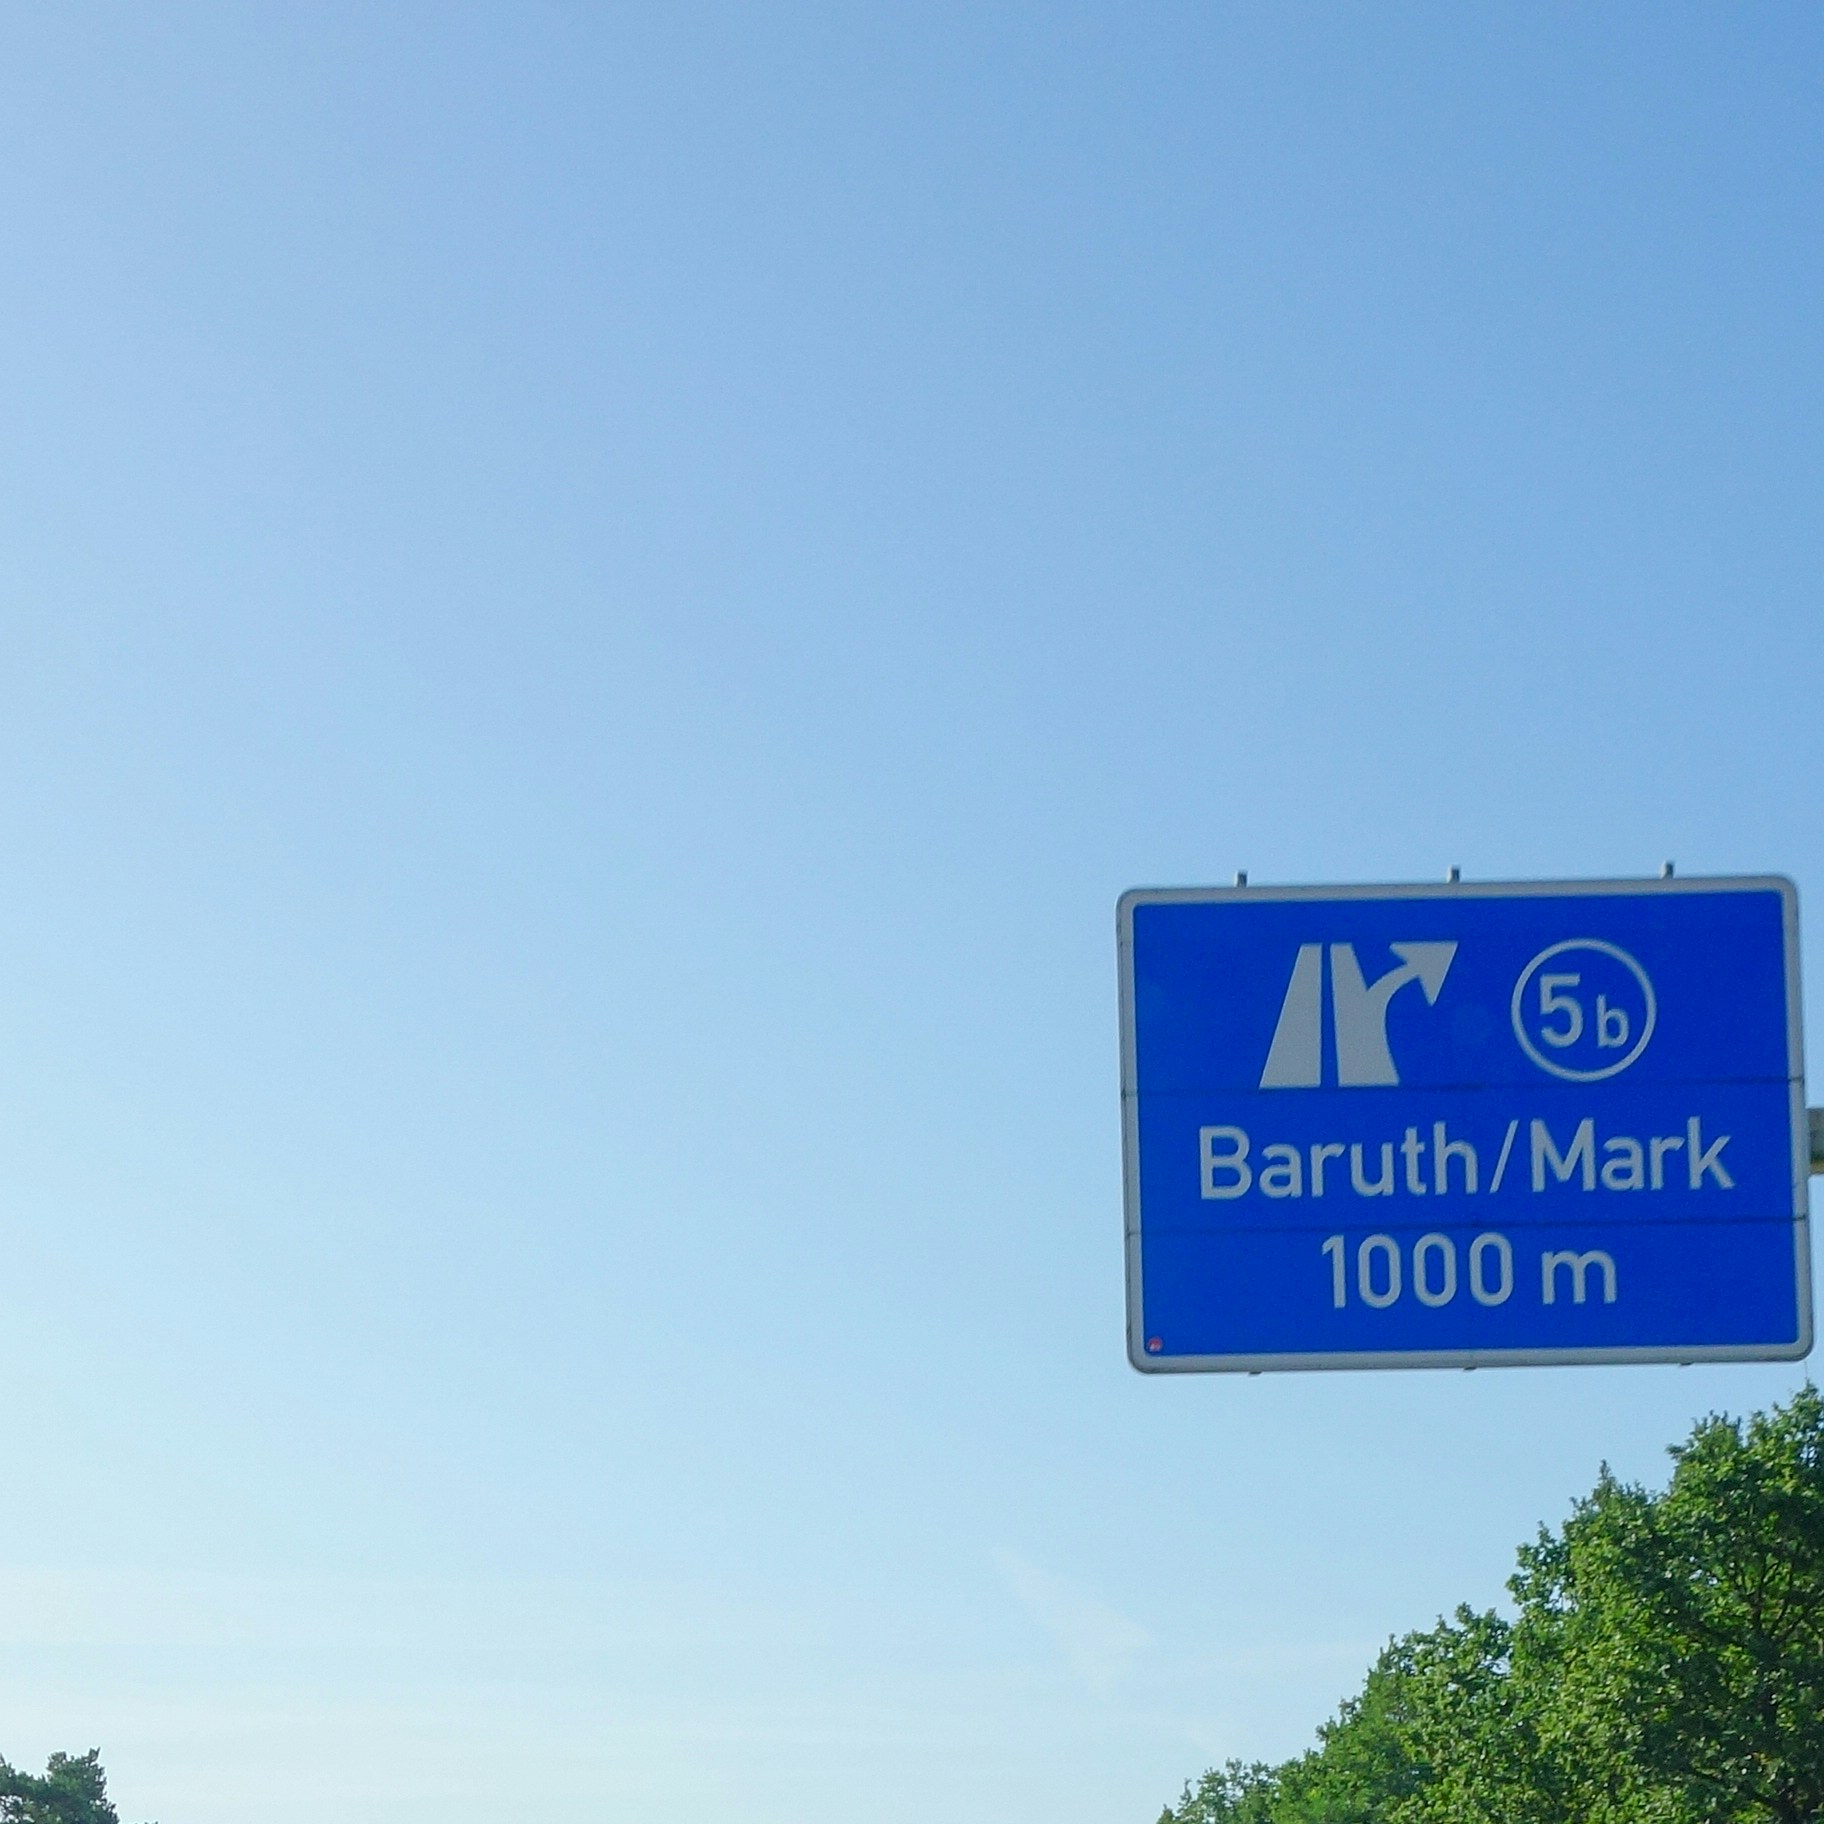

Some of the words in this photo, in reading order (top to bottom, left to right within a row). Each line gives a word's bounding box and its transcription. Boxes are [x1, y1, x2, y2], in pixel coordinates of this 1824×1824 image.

[1539, 973, 1630, 1050] 5b
[1198, 1116, 1735, 1200] Baruth/Mark
[1321, 1232, 1513, 1308] 1000
[1542, 1248, 1617, 1304] m
